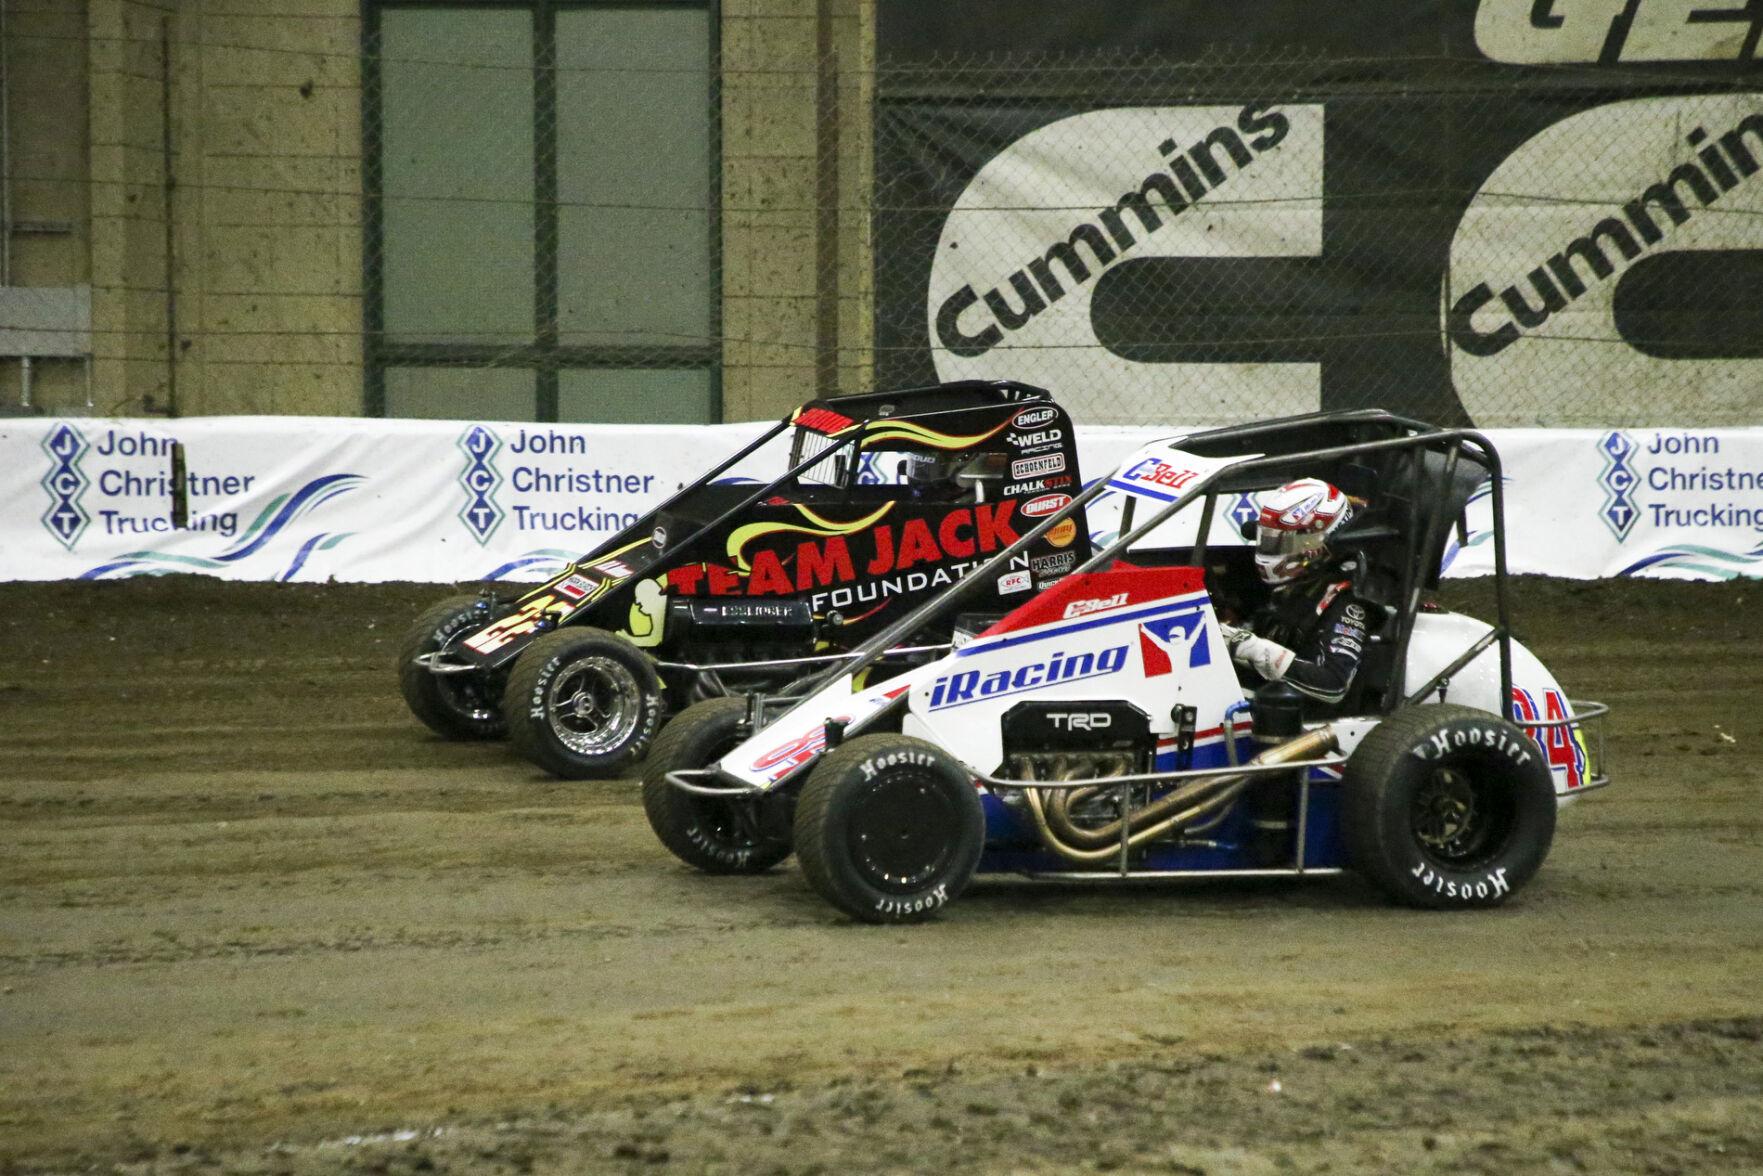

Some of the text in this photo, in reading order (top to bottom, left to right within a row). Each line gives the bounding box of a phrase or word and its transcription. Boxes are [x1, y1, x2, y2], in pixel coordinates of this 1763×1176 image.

[936, 102, 1290, 358] Cummins
[1018, 410, 1054, 425] ENGLER
[510, 429, 586, 454] John
[1018, 429, 1062, 447] WELD
[1647, 432, 1720, 454] John
[1015, 457, 1061, 474] SCHOENFELD
[512, 467, 655, 493] Christner
[667, 499, 1021, 596] TEAM JACK
[1031, 551, 1075, 572] HARRIS
[812, 550, 1029, 612] FOUNDATN
[929, 645, 1129, 707] iRacing
[1046, 713, 1111, 731] TRD
[1430, 727, 1532, 766] Hoosier
[858, 752, 937, 781] Hoosier
[1411, 861, 1511, 900] Hoosier
[875, 883, 950, 915] Hoosier
